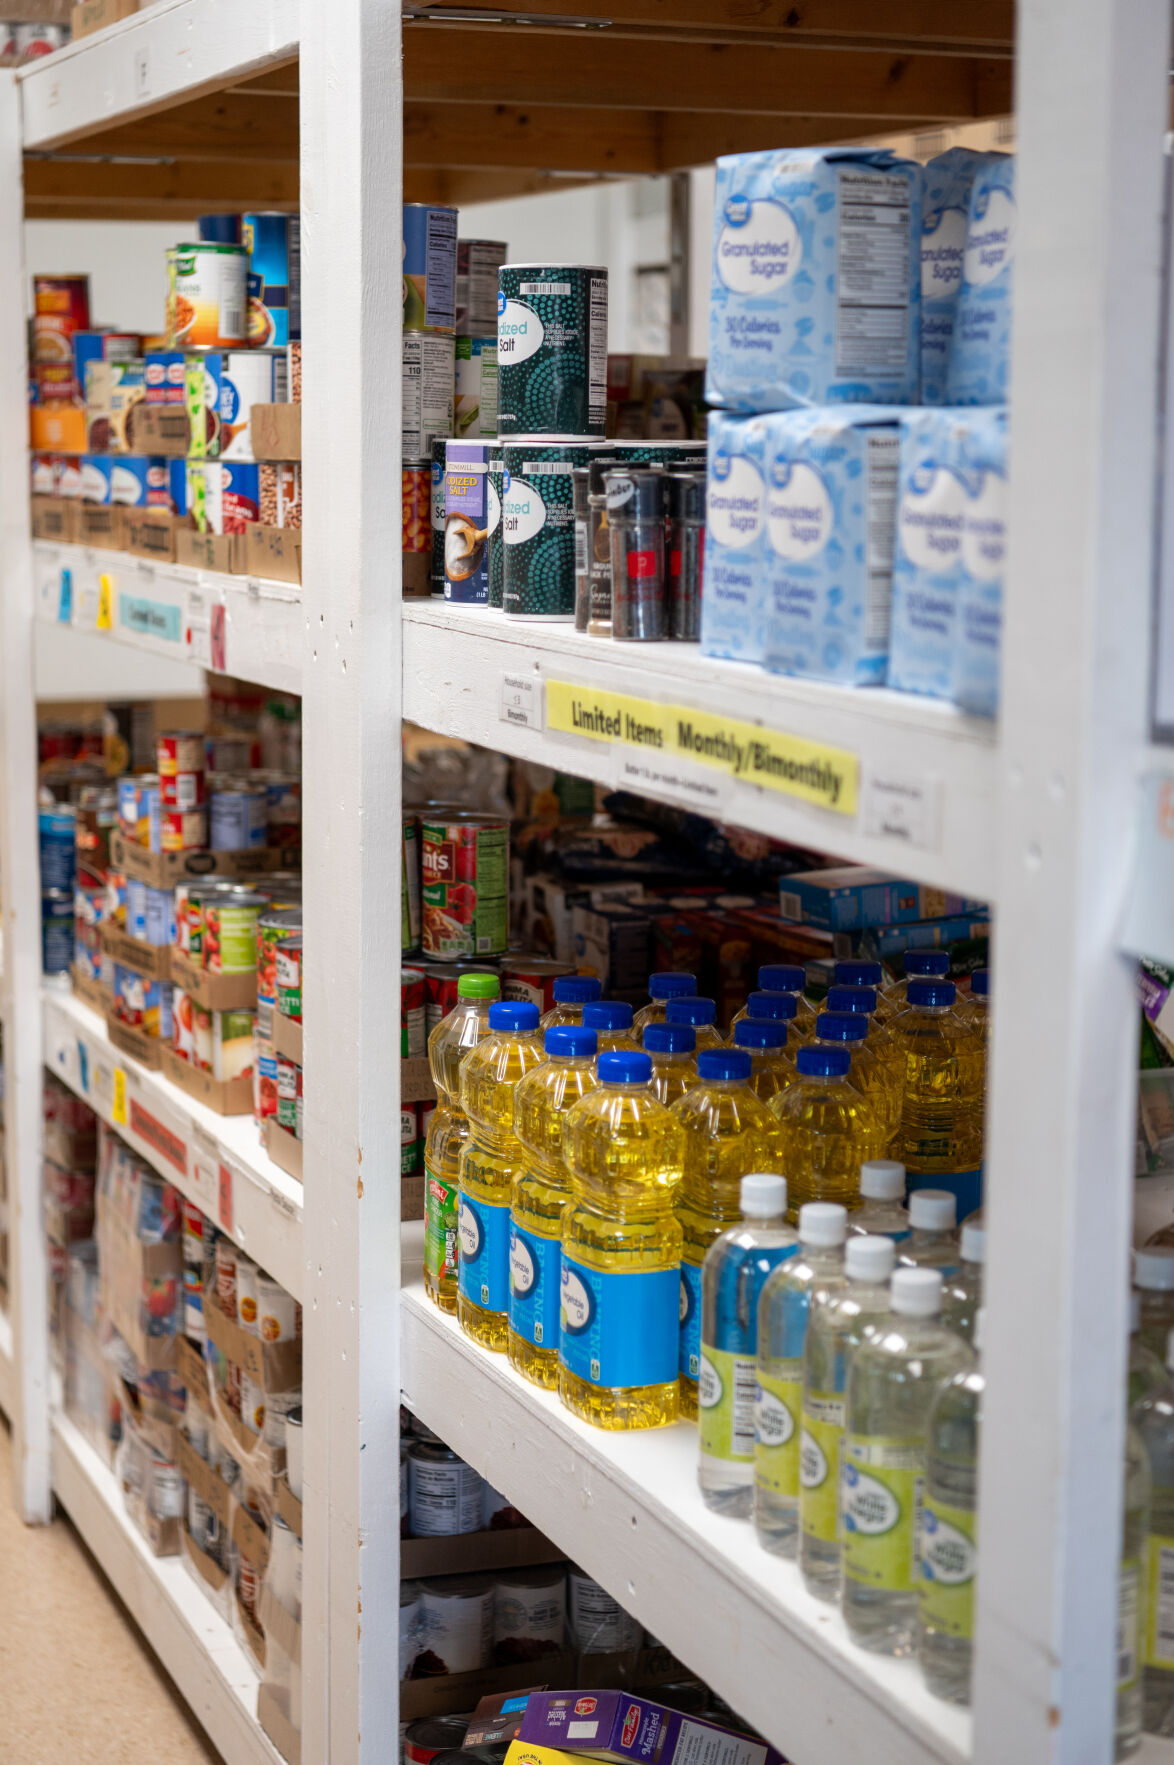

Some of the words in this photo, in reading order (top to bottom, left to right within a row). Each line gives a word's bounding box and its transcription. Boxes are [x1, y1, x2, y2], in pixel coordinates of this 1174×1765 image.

[721, 240, 790, 258] Granulated
[749, 259, 789, 280] Sugar
[740, 316, 782, 336] Calories
[404, 341, 420, 350] Facts
[499, 338, 516, 352] Salt
[408, 366, 421, 375] 110
[449, 486, 469, 496] SALT
[505, 517, 519, 531] Salt
[728, 513, 758, 533] Sugar
[790, 524, 821, 545] Sugar
[504, 676, 524, 691] Household
[507, 708, 529, 725] Bimonthly
[571, 700, 622, 737] Limited
[625, 712, 664, 749] Items
[677, 719, 844, 804] Monthly/Bimonthly
[522, 1274, 530, 1284] Oil
[576, 1310, 585, 1321] Oil
[856, 1495, 886, 1512] White
[627, 1708, 640, 1732] Family
[624, 1730, 632, 1745] Our
[638, 1716, 650, 1746] Homestyle
[641, 1712, 660, 1756] Mashed
